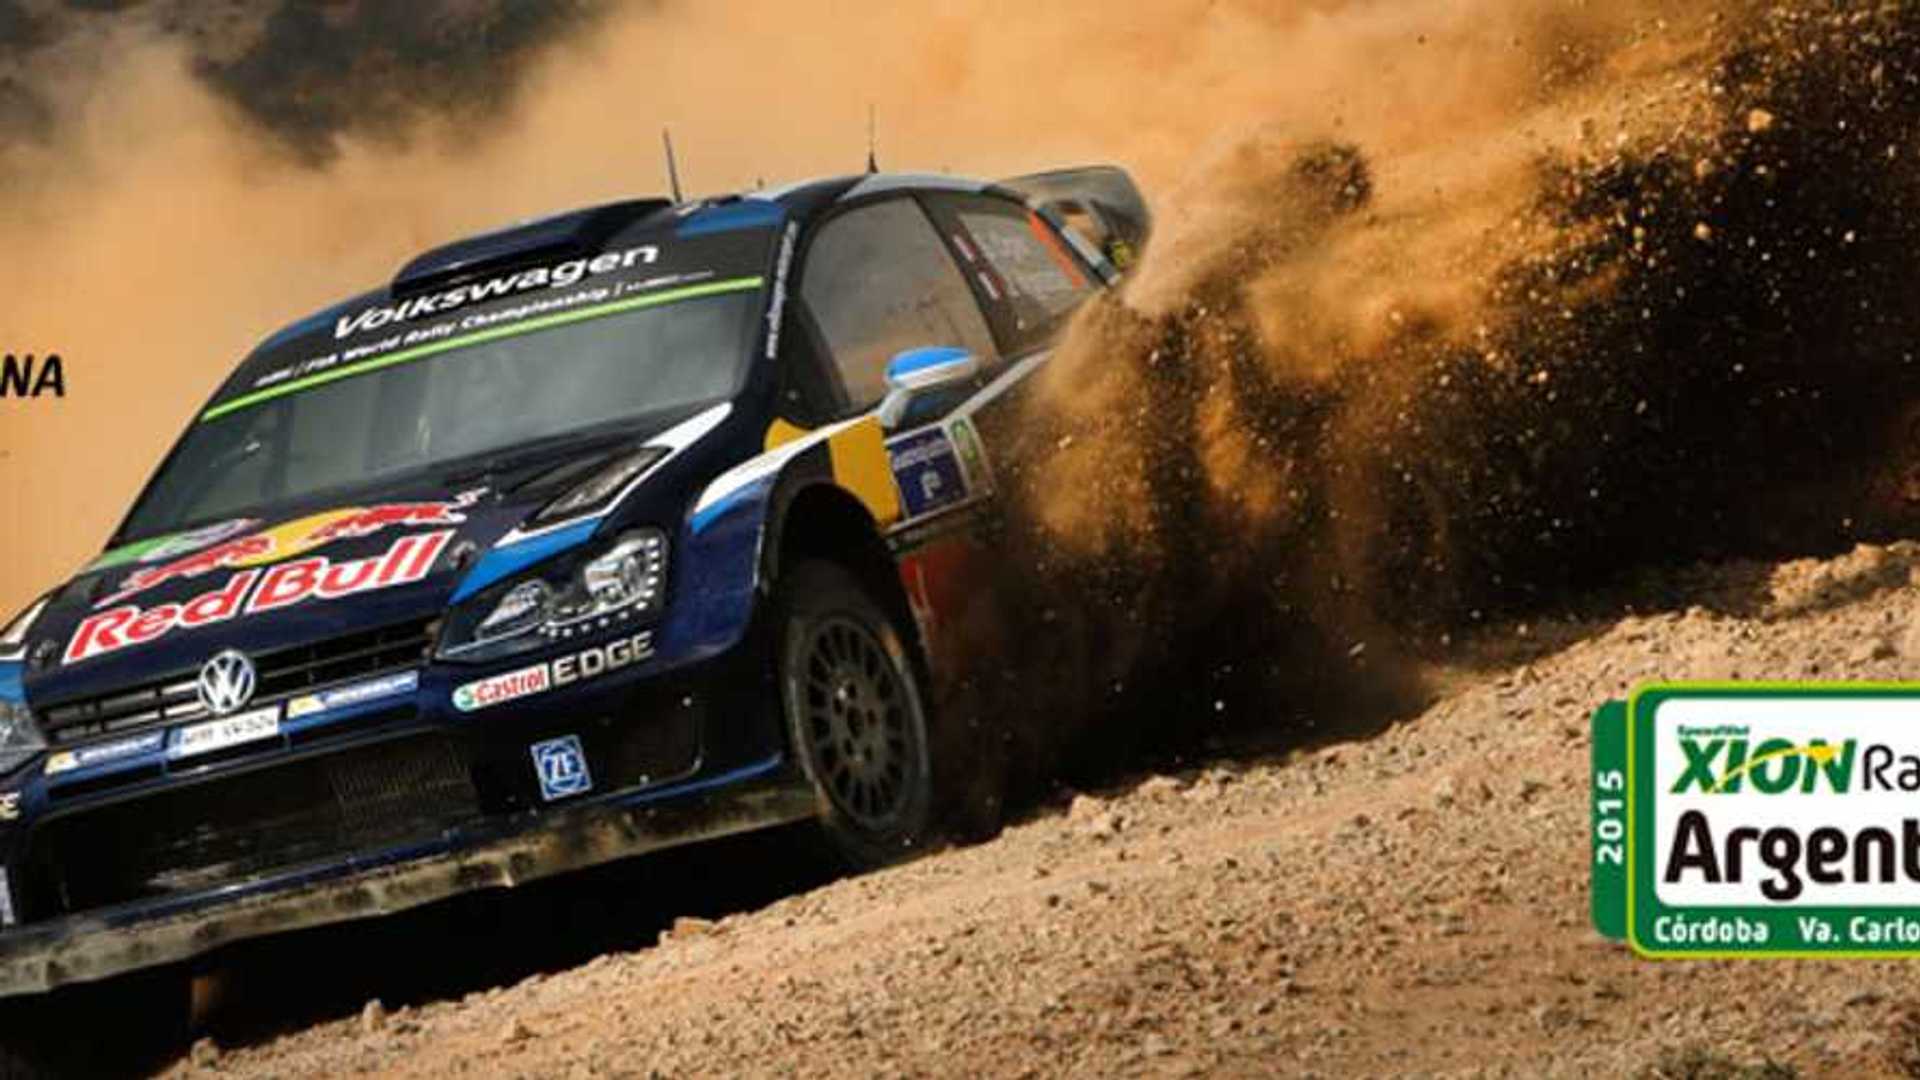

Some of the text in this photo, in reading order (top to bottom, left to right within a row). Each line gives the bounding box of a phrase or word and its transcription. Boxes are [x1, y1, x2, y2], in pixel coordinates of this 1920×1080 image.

[334, 244, 659, 339] Volkswagen
[343, 335, 401, 361] World
[404, 321, 457, 346] Rally
[461, 286, 608, 328] Championship
[62, 567, 257, 664] Red
[244, 529, 456, 614] Bull
[475, 631, 655, 703] Castrol EDGE
